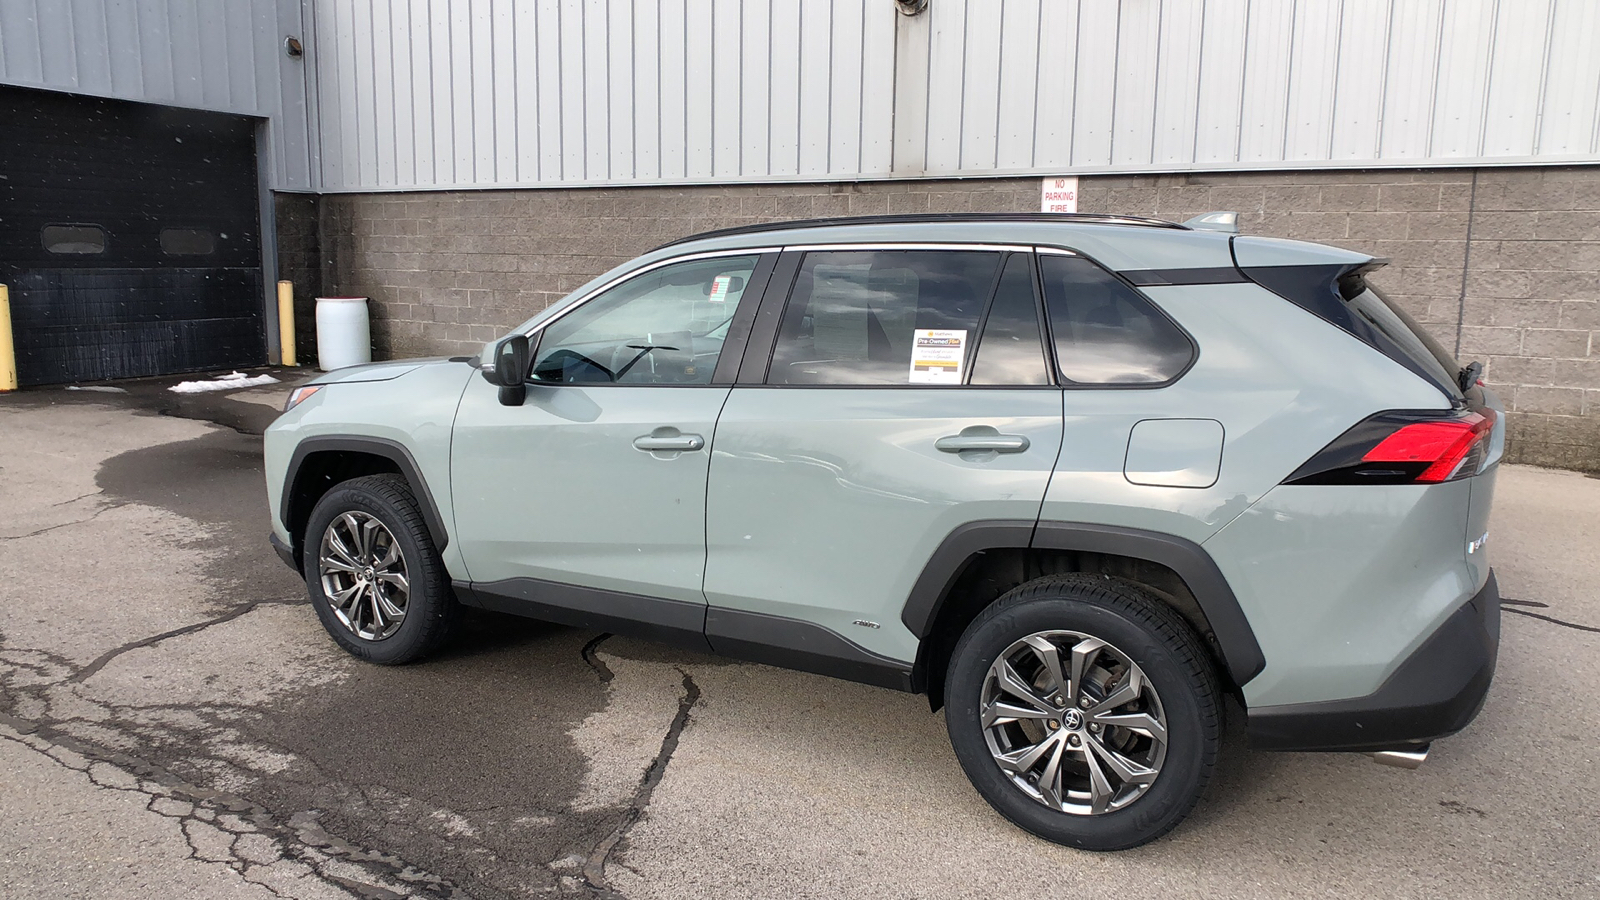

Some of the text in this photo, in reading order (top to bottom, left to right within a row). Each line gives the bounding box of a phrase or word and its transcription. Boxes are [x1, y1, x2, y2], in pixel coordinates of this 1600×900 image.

[1055, 179, 1065, 189] NO
[1045, 191, 1074, 201] PARKING
[1050, 204, 1068, 212] FIRE
